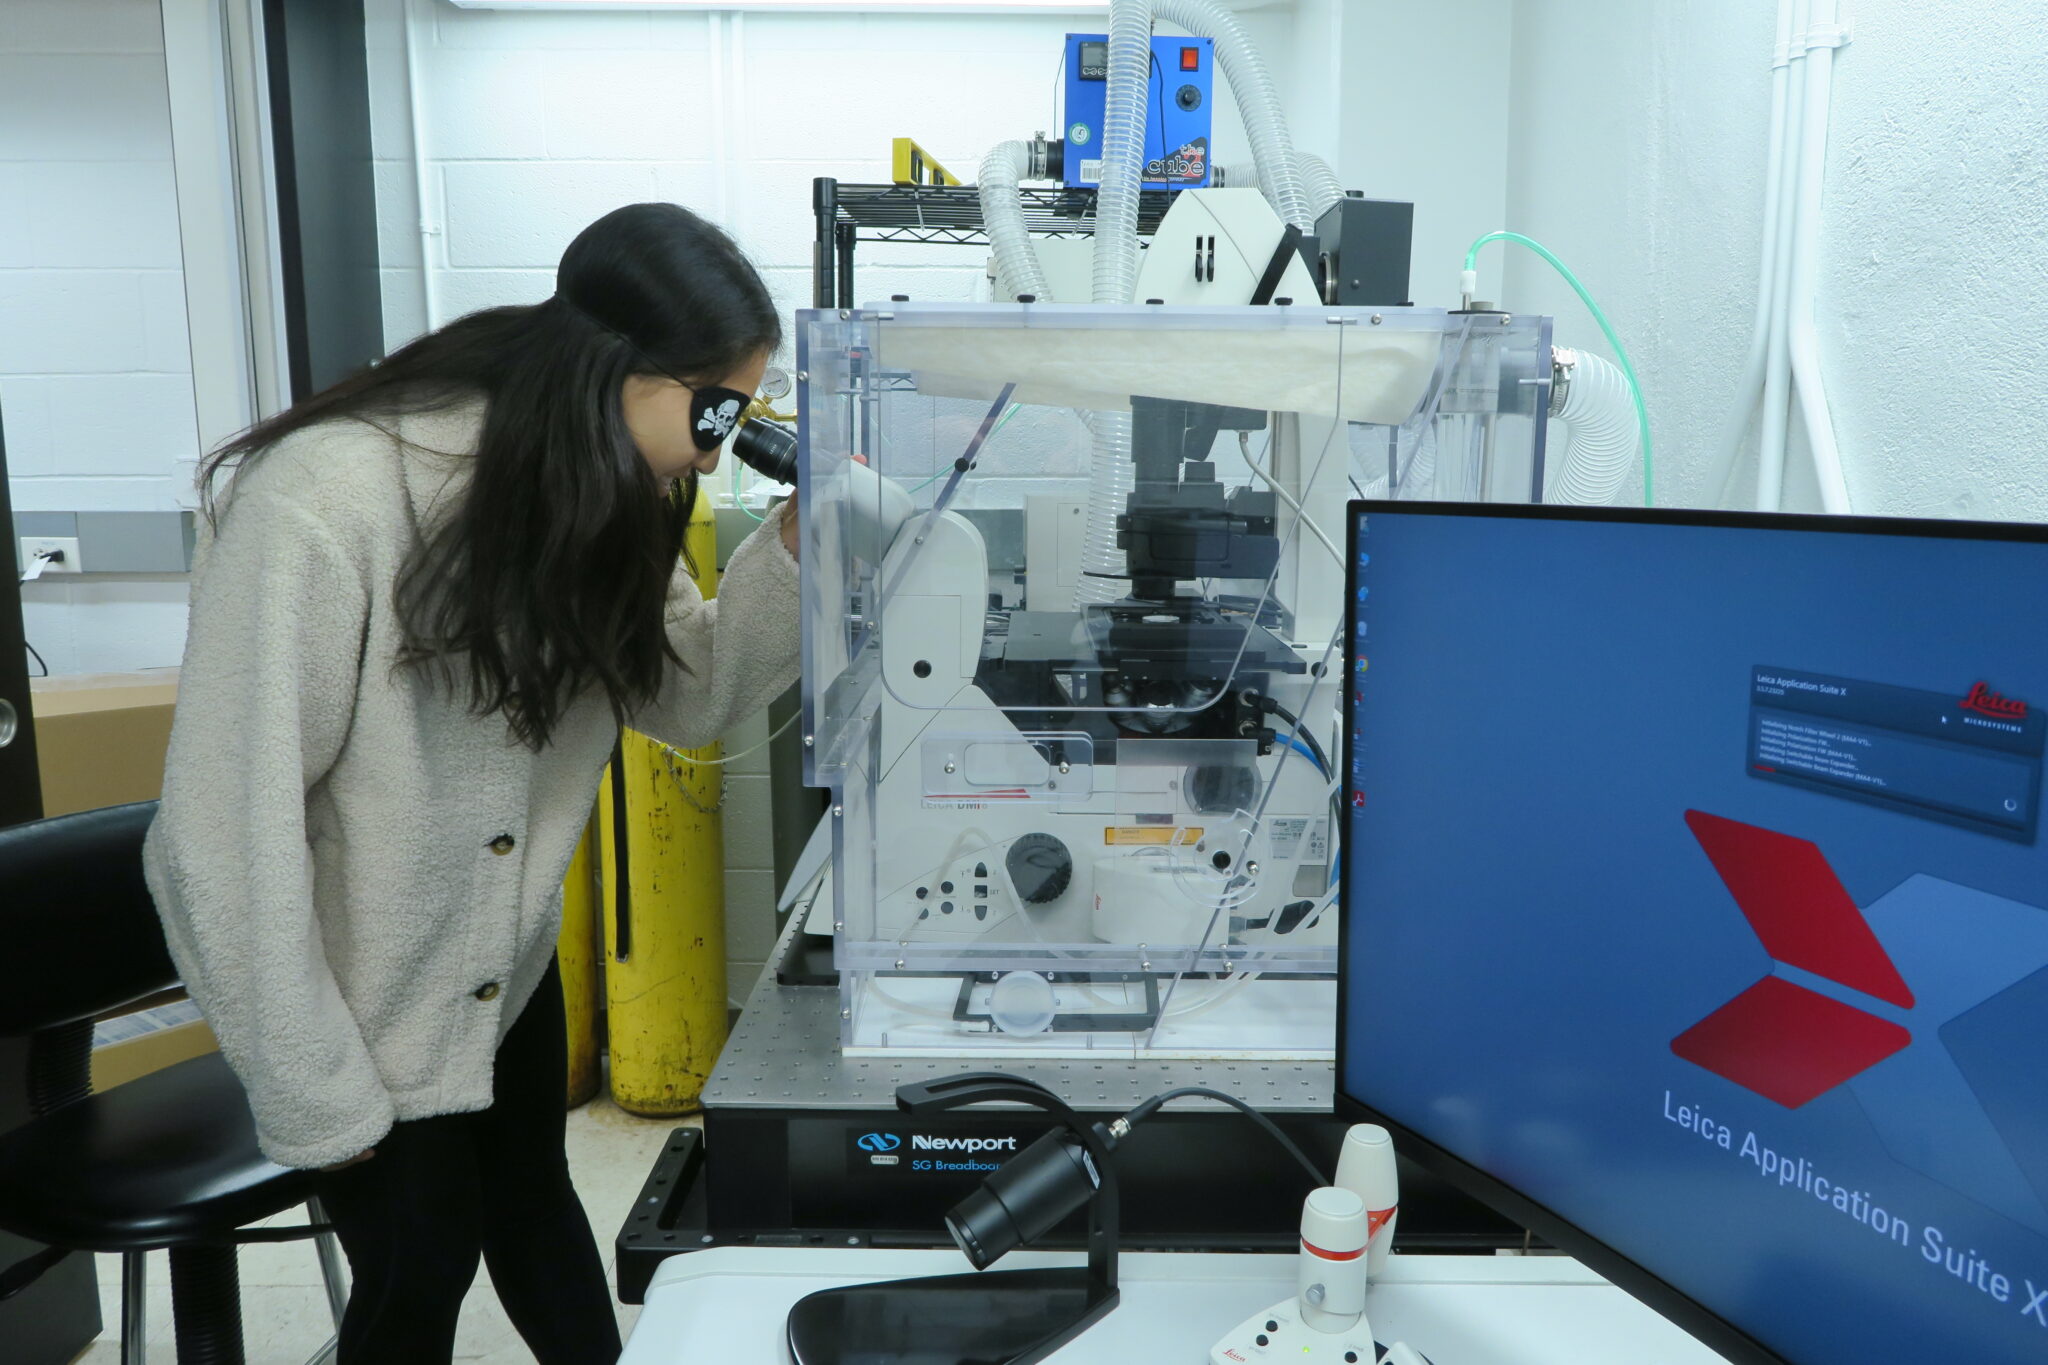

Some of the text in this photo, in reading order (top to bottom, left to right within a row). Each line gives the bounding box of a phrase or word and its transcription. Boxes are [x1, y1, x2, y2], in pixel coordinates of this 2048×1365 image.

[1180, 144, 1204, 155] the
[1147, 155, 1204, 175] cube
[1756, 674, 1847, 696] Leica Application Suite X
[1957, 681, 2027, 719] Leica
[1963, 717, 2022, 733] MICROSYSTEMS
[912, 1135, 1016, 1153] Newport
[912, 1160, 931, 1170] SG
[1664, 1090, 2048, 1328] Leica Application Suite X
[1223, 1348, 1246, 1362] Leica
